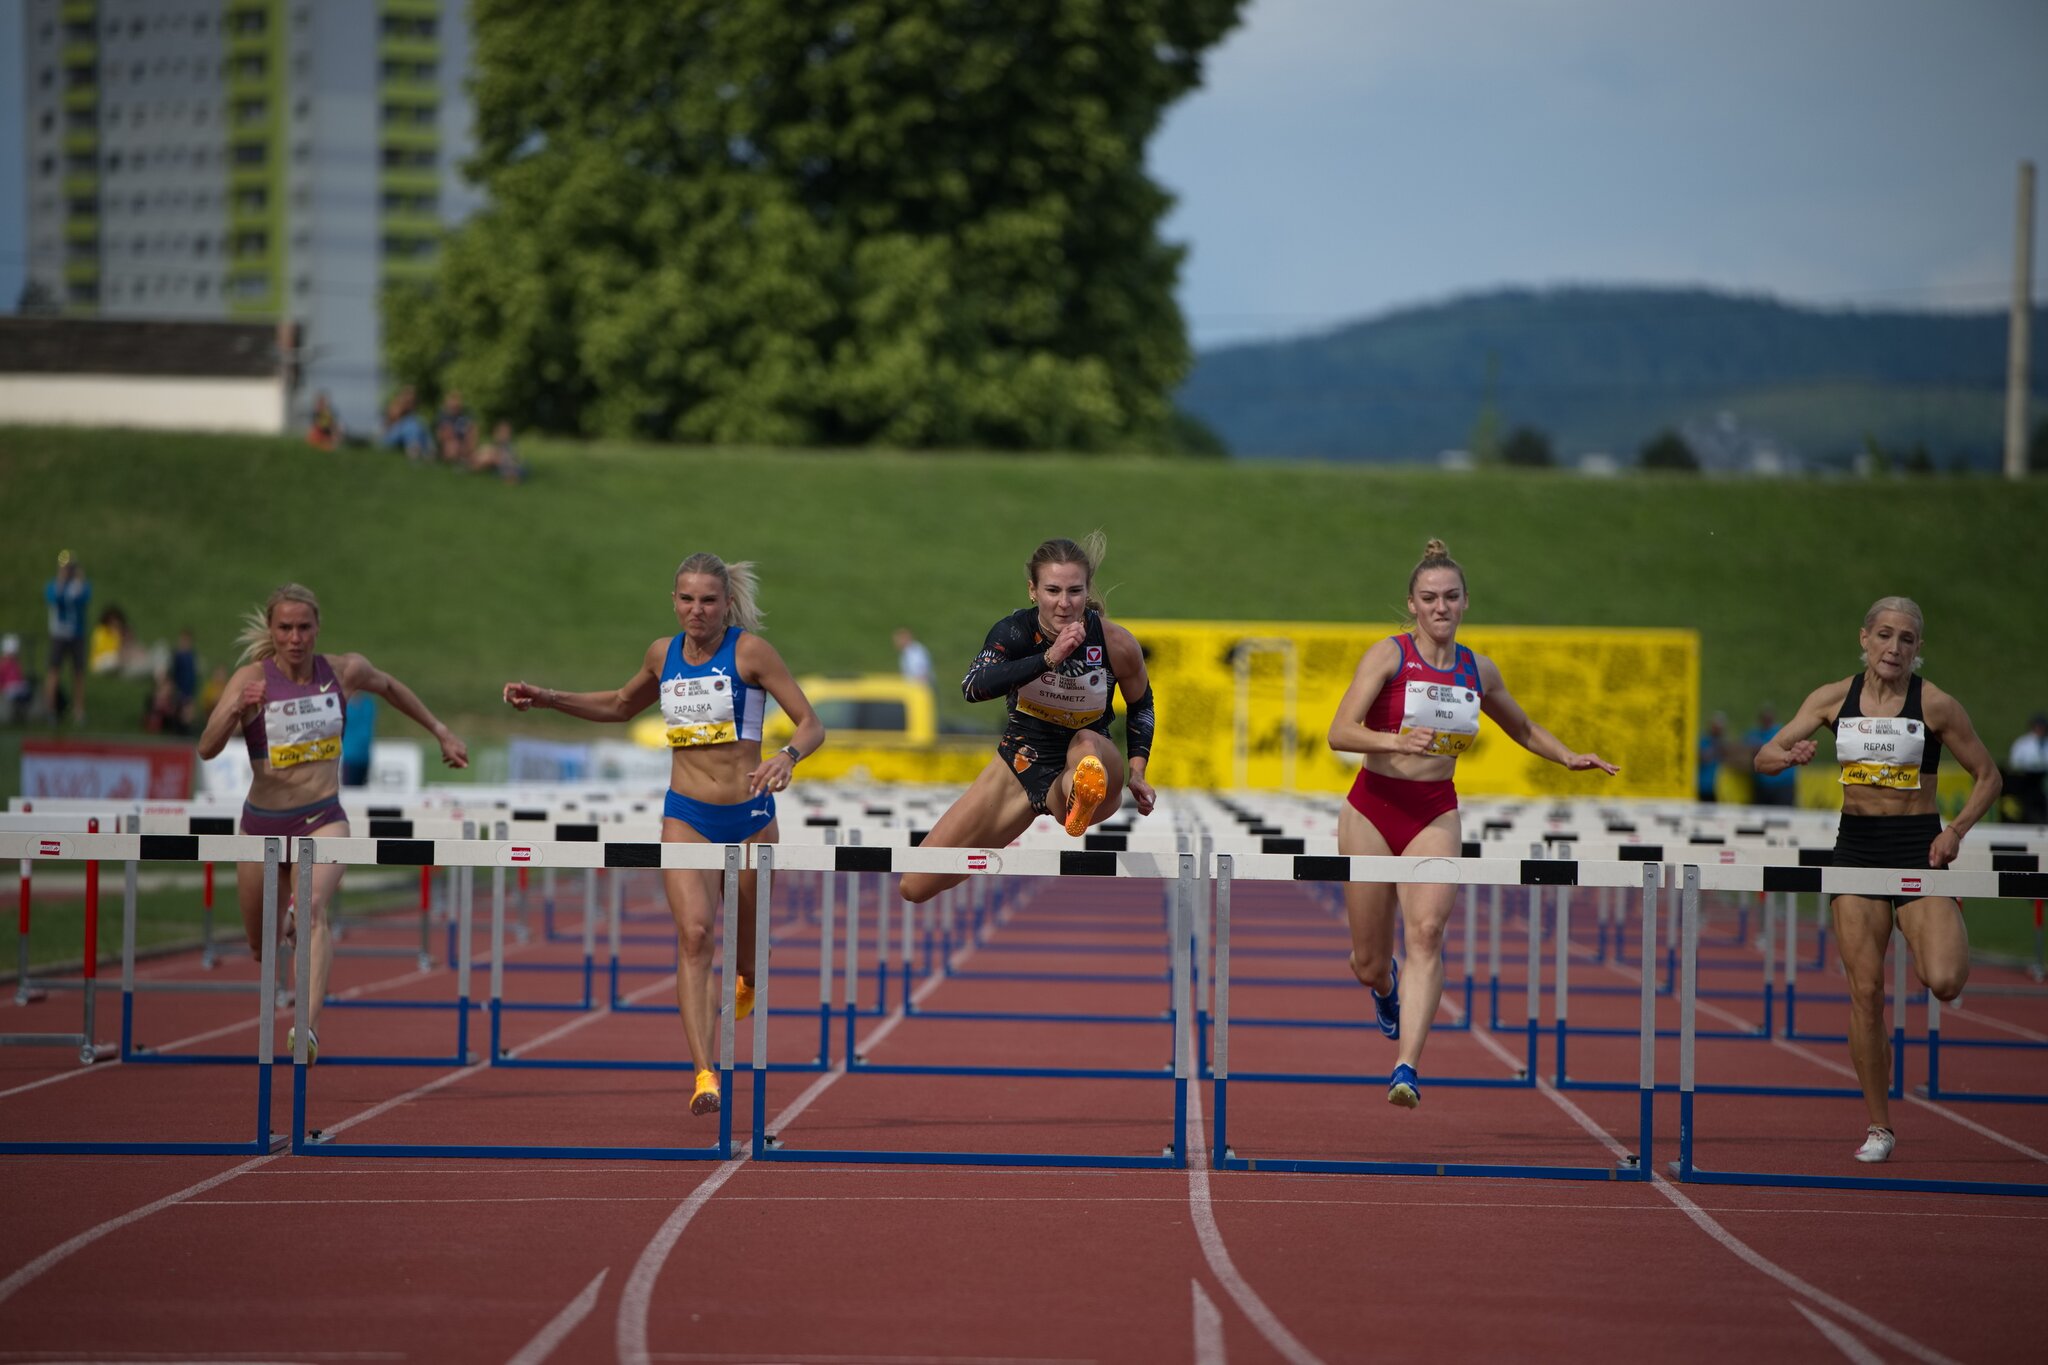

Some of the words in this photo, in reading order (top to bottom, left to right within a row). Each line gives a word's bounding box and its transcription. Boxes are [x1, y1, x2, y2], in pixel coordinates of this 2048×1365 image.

[1039, 690, 1086, 702] STRAMETZ
[674, 703, 712, 714] ZAPALSKA
[1435, 709, 1453, 719] WILD
[286, 720, 326, 732] HELTBECH
[1863, 742, 1895, 752] REPASI
[279, 752, 300, 762] Lucky
[1848, 769, 1867, 781] Lucky
[1897, 771, 1911, 781] Car
